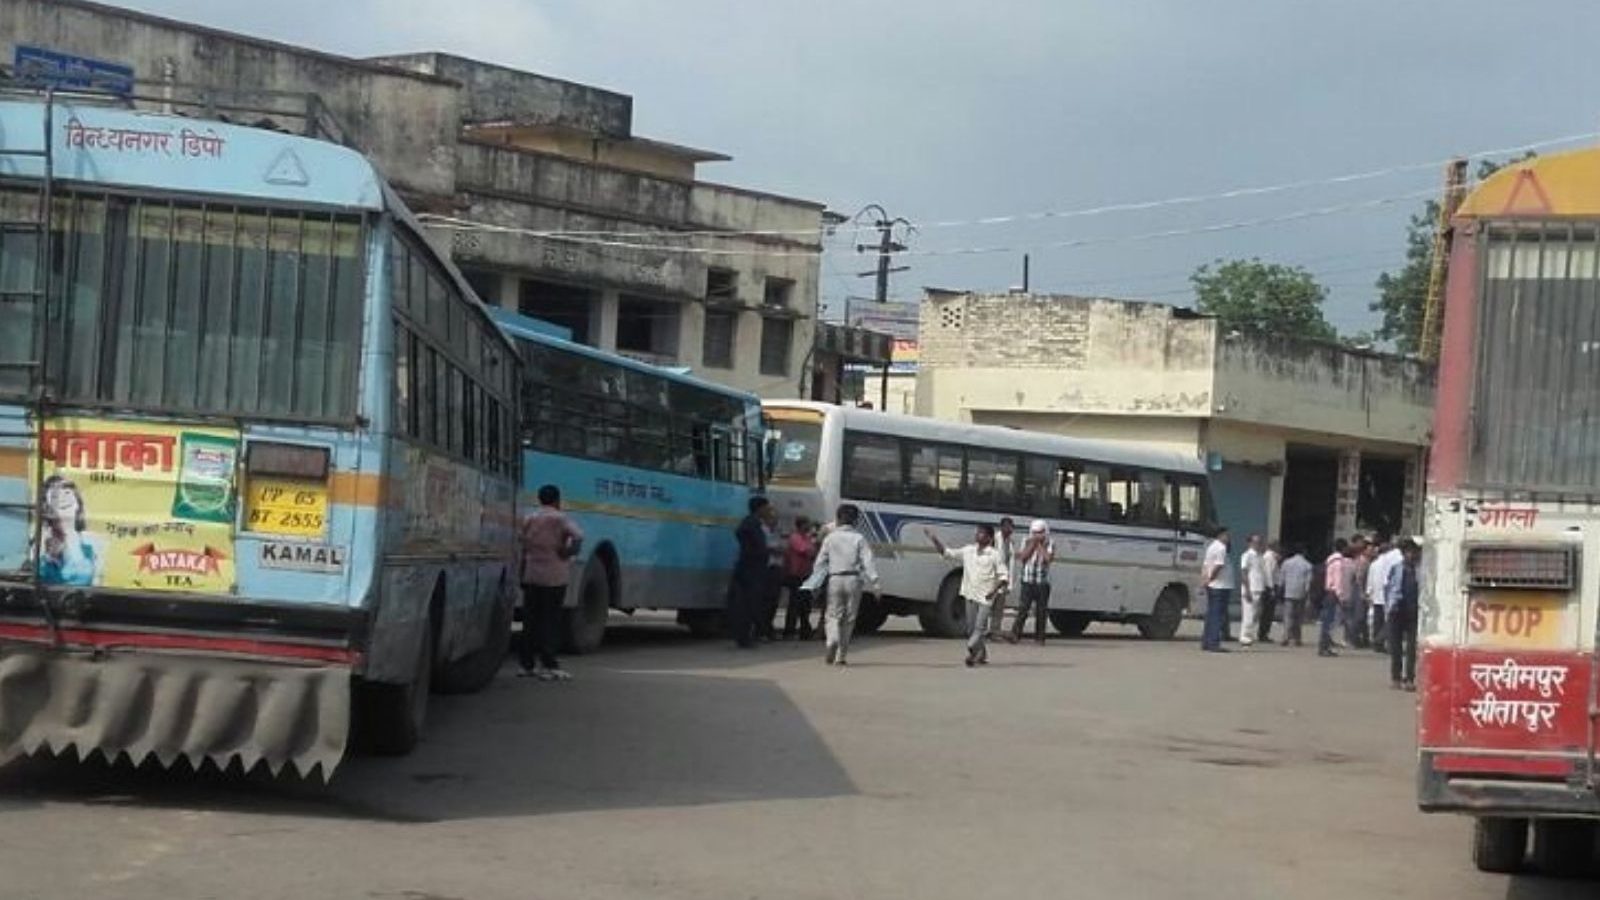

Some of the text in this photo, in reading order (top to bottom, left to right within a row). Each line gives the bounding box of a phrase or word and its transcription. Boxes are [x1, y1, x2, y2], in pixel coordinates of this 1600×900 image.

[40, 430, 176, 472] पताका
[149, 552, 208, 573] PATAKA
[262, 543, 342, 566] KAMAL
[166, 575, 193, 587] TEA
[1469, 600, 1543, 638] STOP
[1470, 658, 1568, 698] लखीमपुर
[1468, 691, 1562, 733] सीतापुर
